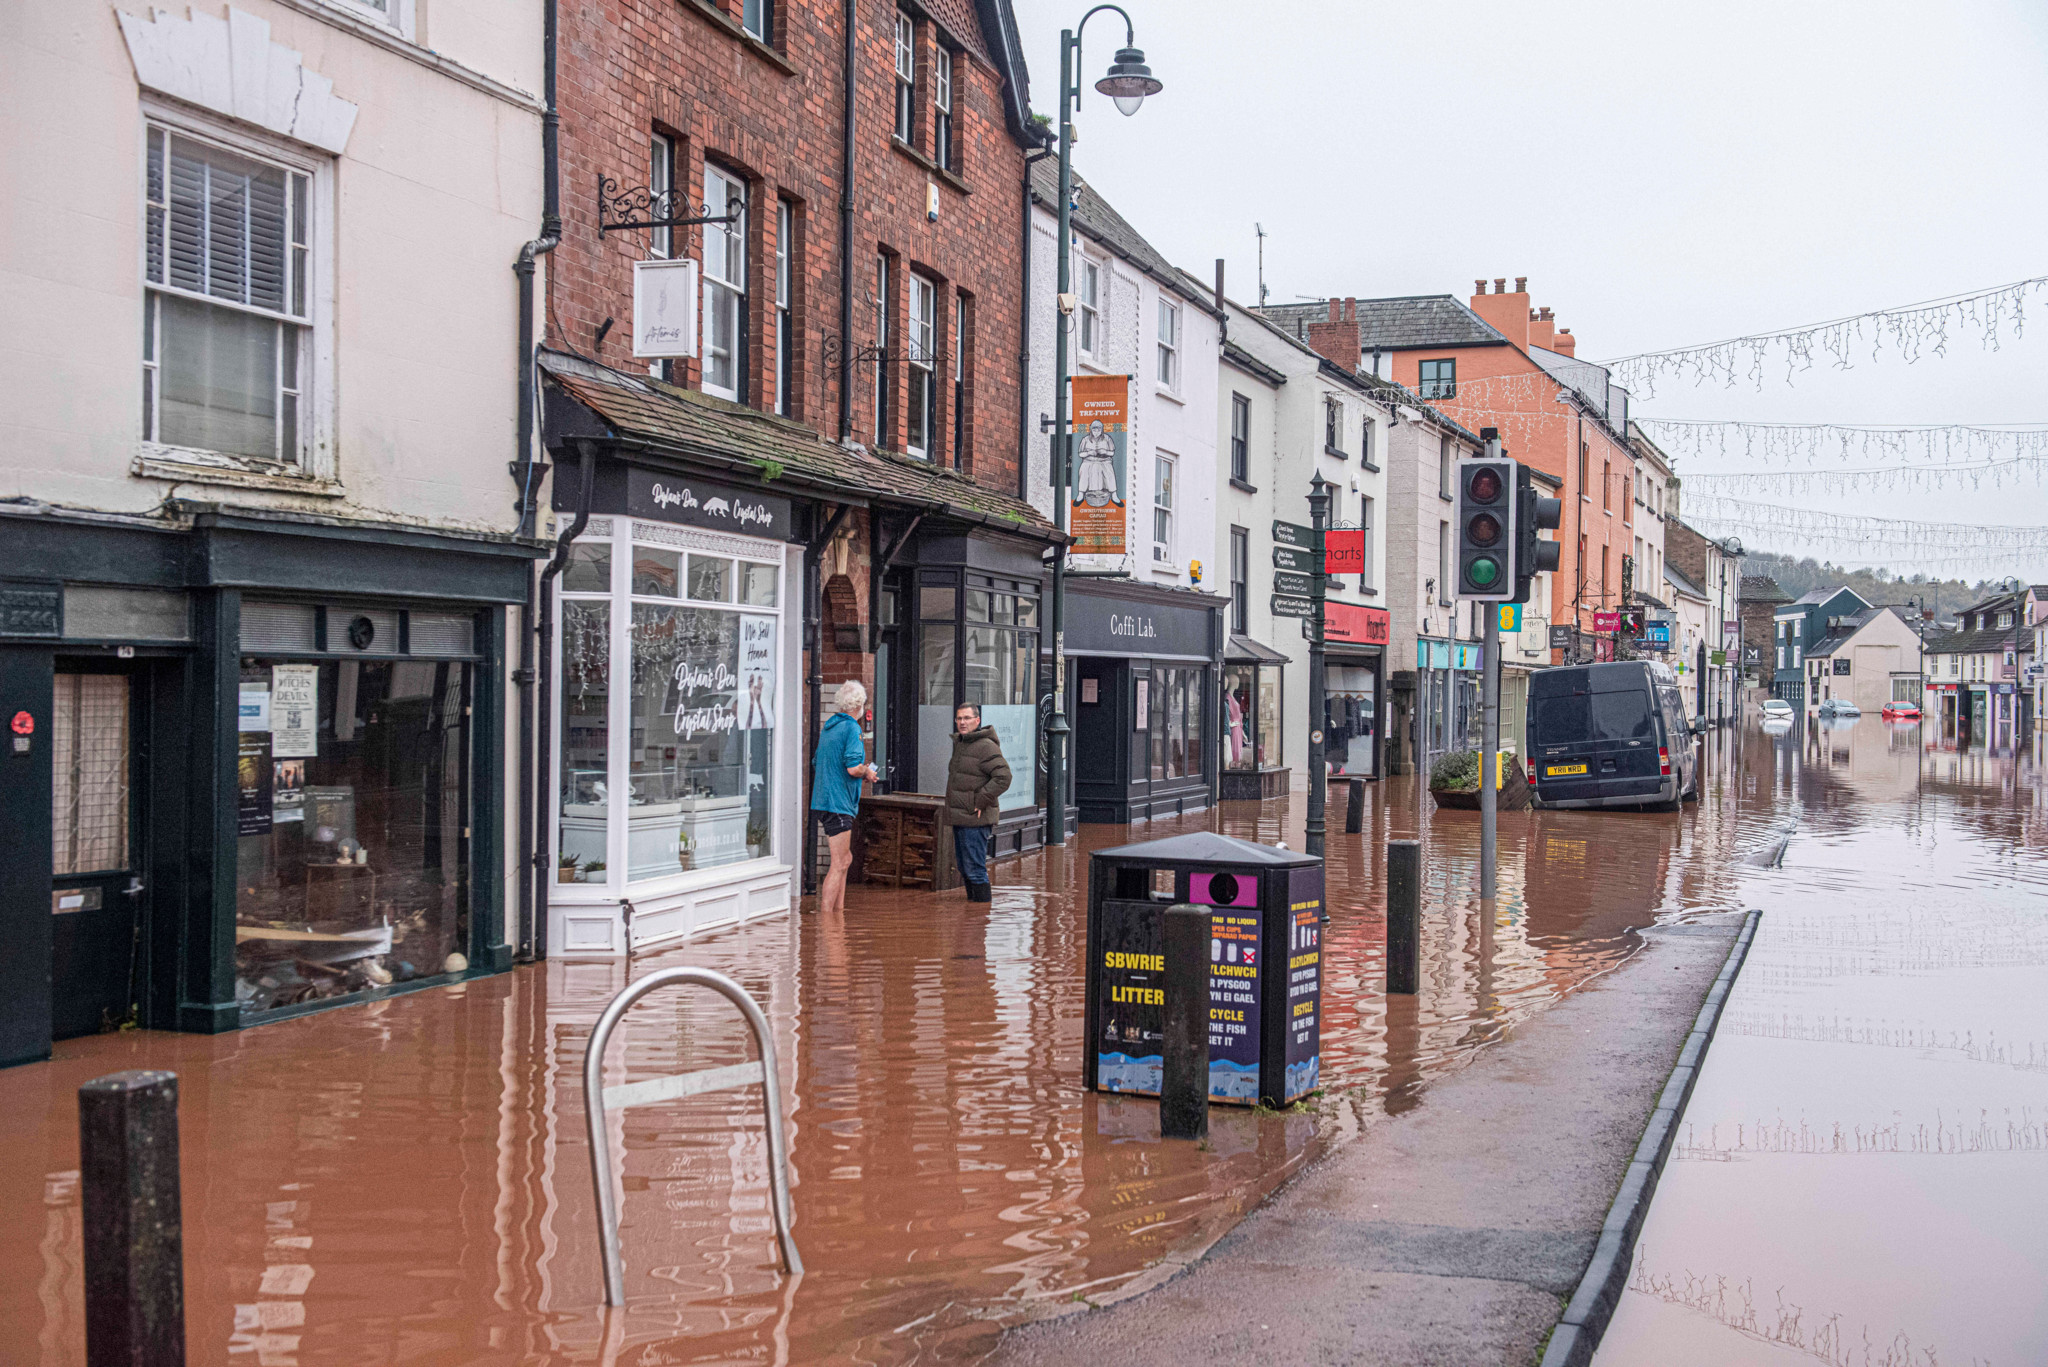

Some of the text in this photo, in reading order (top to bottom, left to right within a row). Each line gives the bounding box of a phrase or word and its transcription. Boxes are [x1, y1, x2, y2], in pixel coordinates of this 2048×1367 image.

[652, 483, 773, 527] Dylan's Den Crystal Shop
[744, 620, 771, 641] We Sell
[1111, 614, 1157, 638] Coffi Lab.
[747, 643, 769, 662] Henna
[675, 662, 736, 697] Dylan's Den
[277, 691, 308, 701] DEVILS
[674, 703, 737, 741] Crystal Shop
[1105, 951, 1165, 971] SBWRIE
[1217, 979, 1251, 991] PYSGOD
[1112, 985, 1165, 1006] LITTER
[1223, 991, 1232, 1002] EI
[1233, 992, 1256, 1004] GAEL
[1209, 1008, 1245, 1022] CYCLE
[1293, 1000, 1314, 1017] RECYCLE
[1225, 1024, 1247, 1036] FISH
[1224, 1036, 1234, 1047] IT
